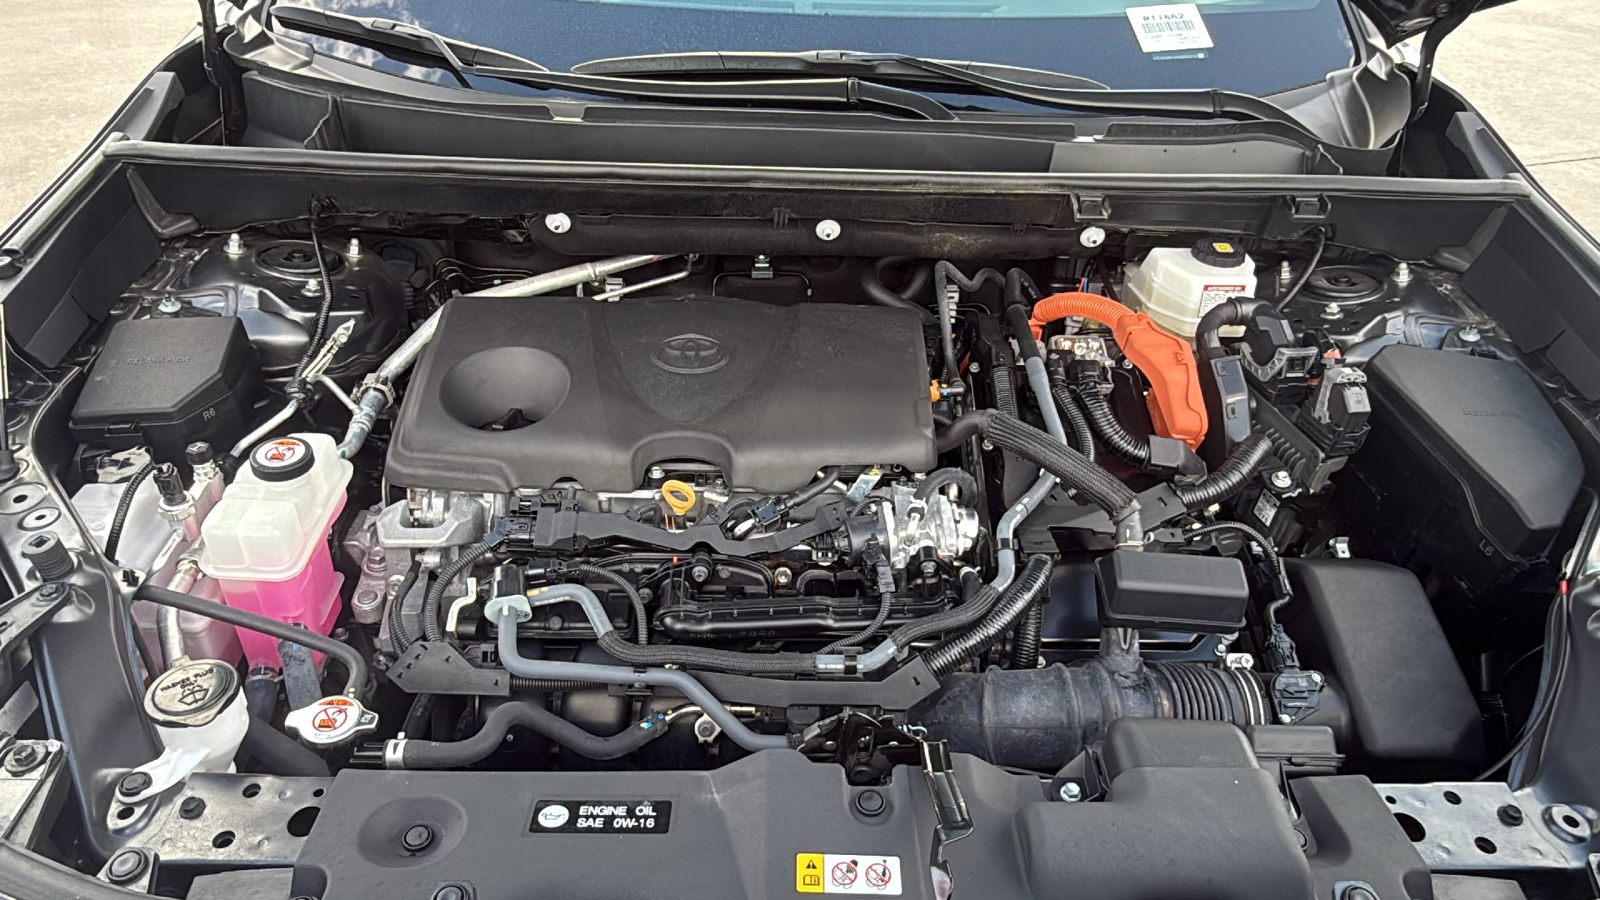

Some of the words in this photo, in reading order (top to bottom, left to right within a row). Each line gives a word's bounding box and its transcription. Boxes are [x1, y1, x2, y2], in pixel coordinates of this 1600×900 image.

[203, 408, 216, 421] R6
[1479, 539, 1493, 556] L6
[160, 677, 190, 692] WASHER
[180, 680, 198, 689] ONLY
[579, 806, 627, 815] ENGINE
[635, 806, 657, 815] OIL
[576, 818, 604, 828] SAE
[613, 818, 655, 828] 0W-16
